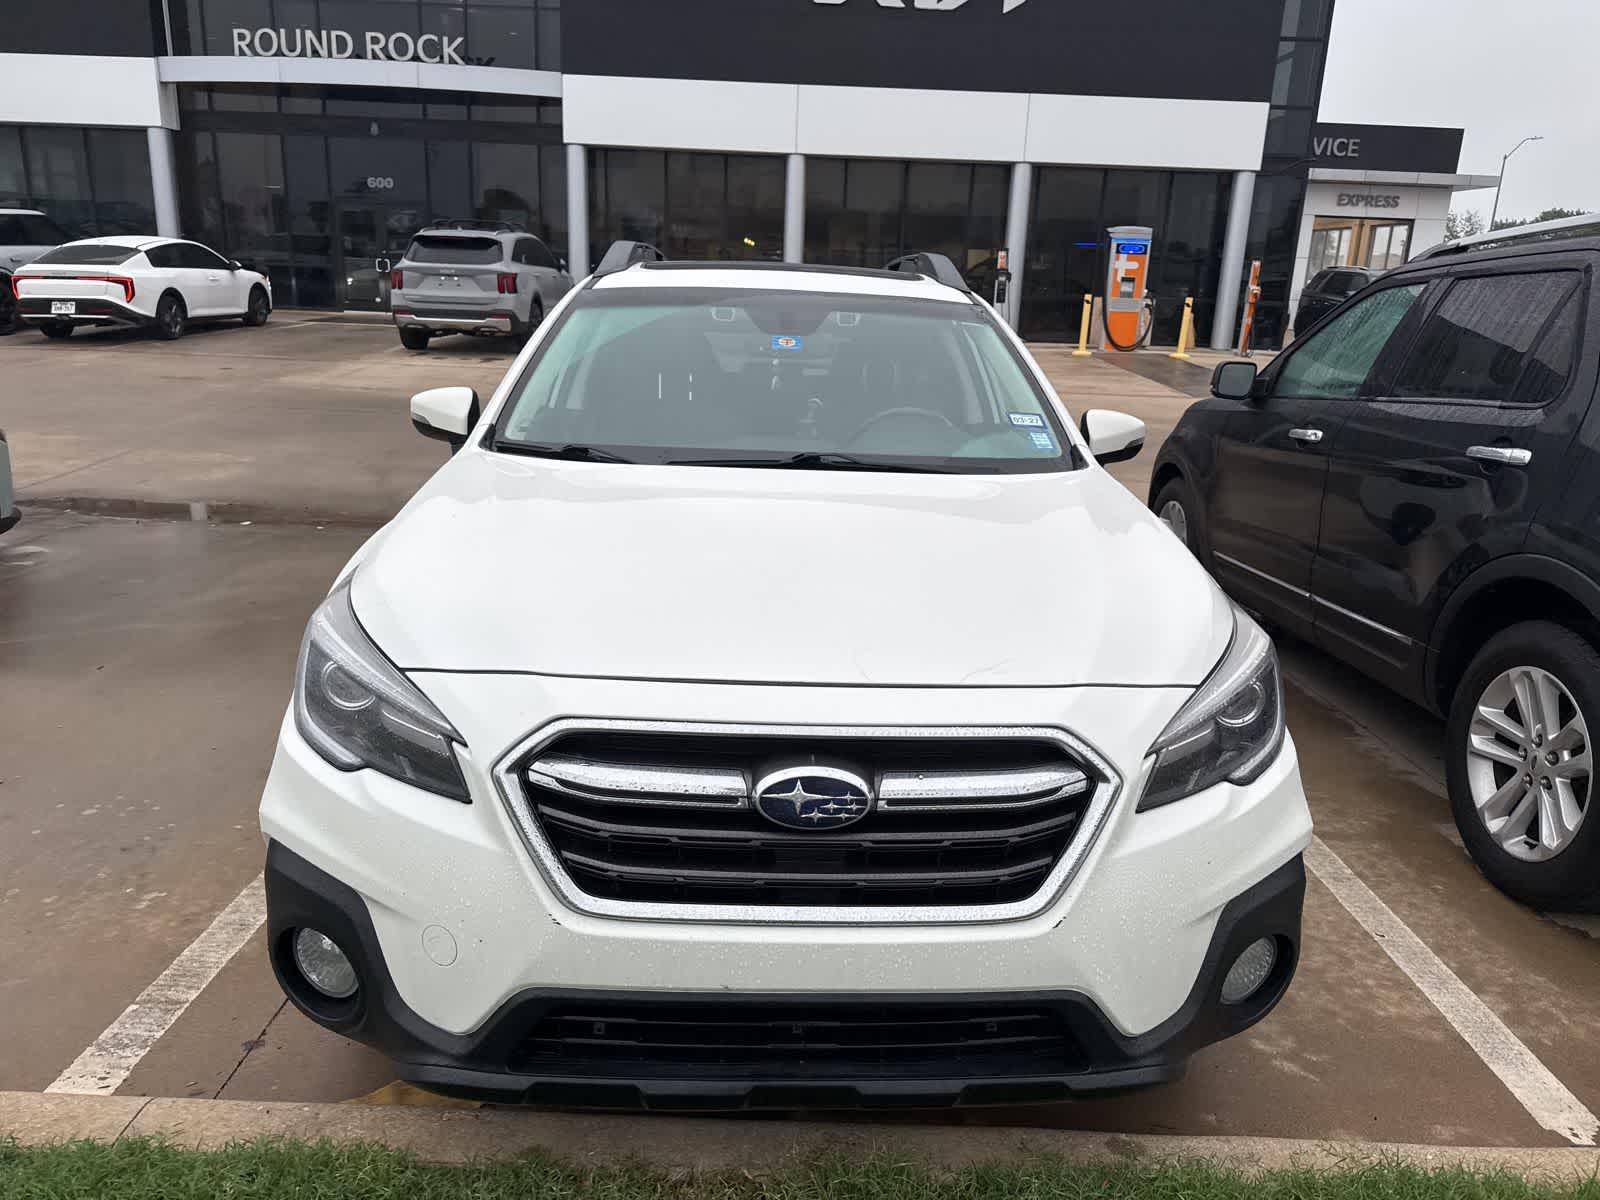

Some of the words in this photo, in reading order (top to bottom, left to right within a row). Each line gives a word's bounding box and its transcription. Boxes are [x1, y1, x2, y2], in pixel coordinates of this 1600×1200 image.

[232, 27, 353, 59] ROUND
[365, 31, 465, 65] ROCK
[367, 176, 394, 189] 600
[1336, 193, 1400, 208] EXPRESS
